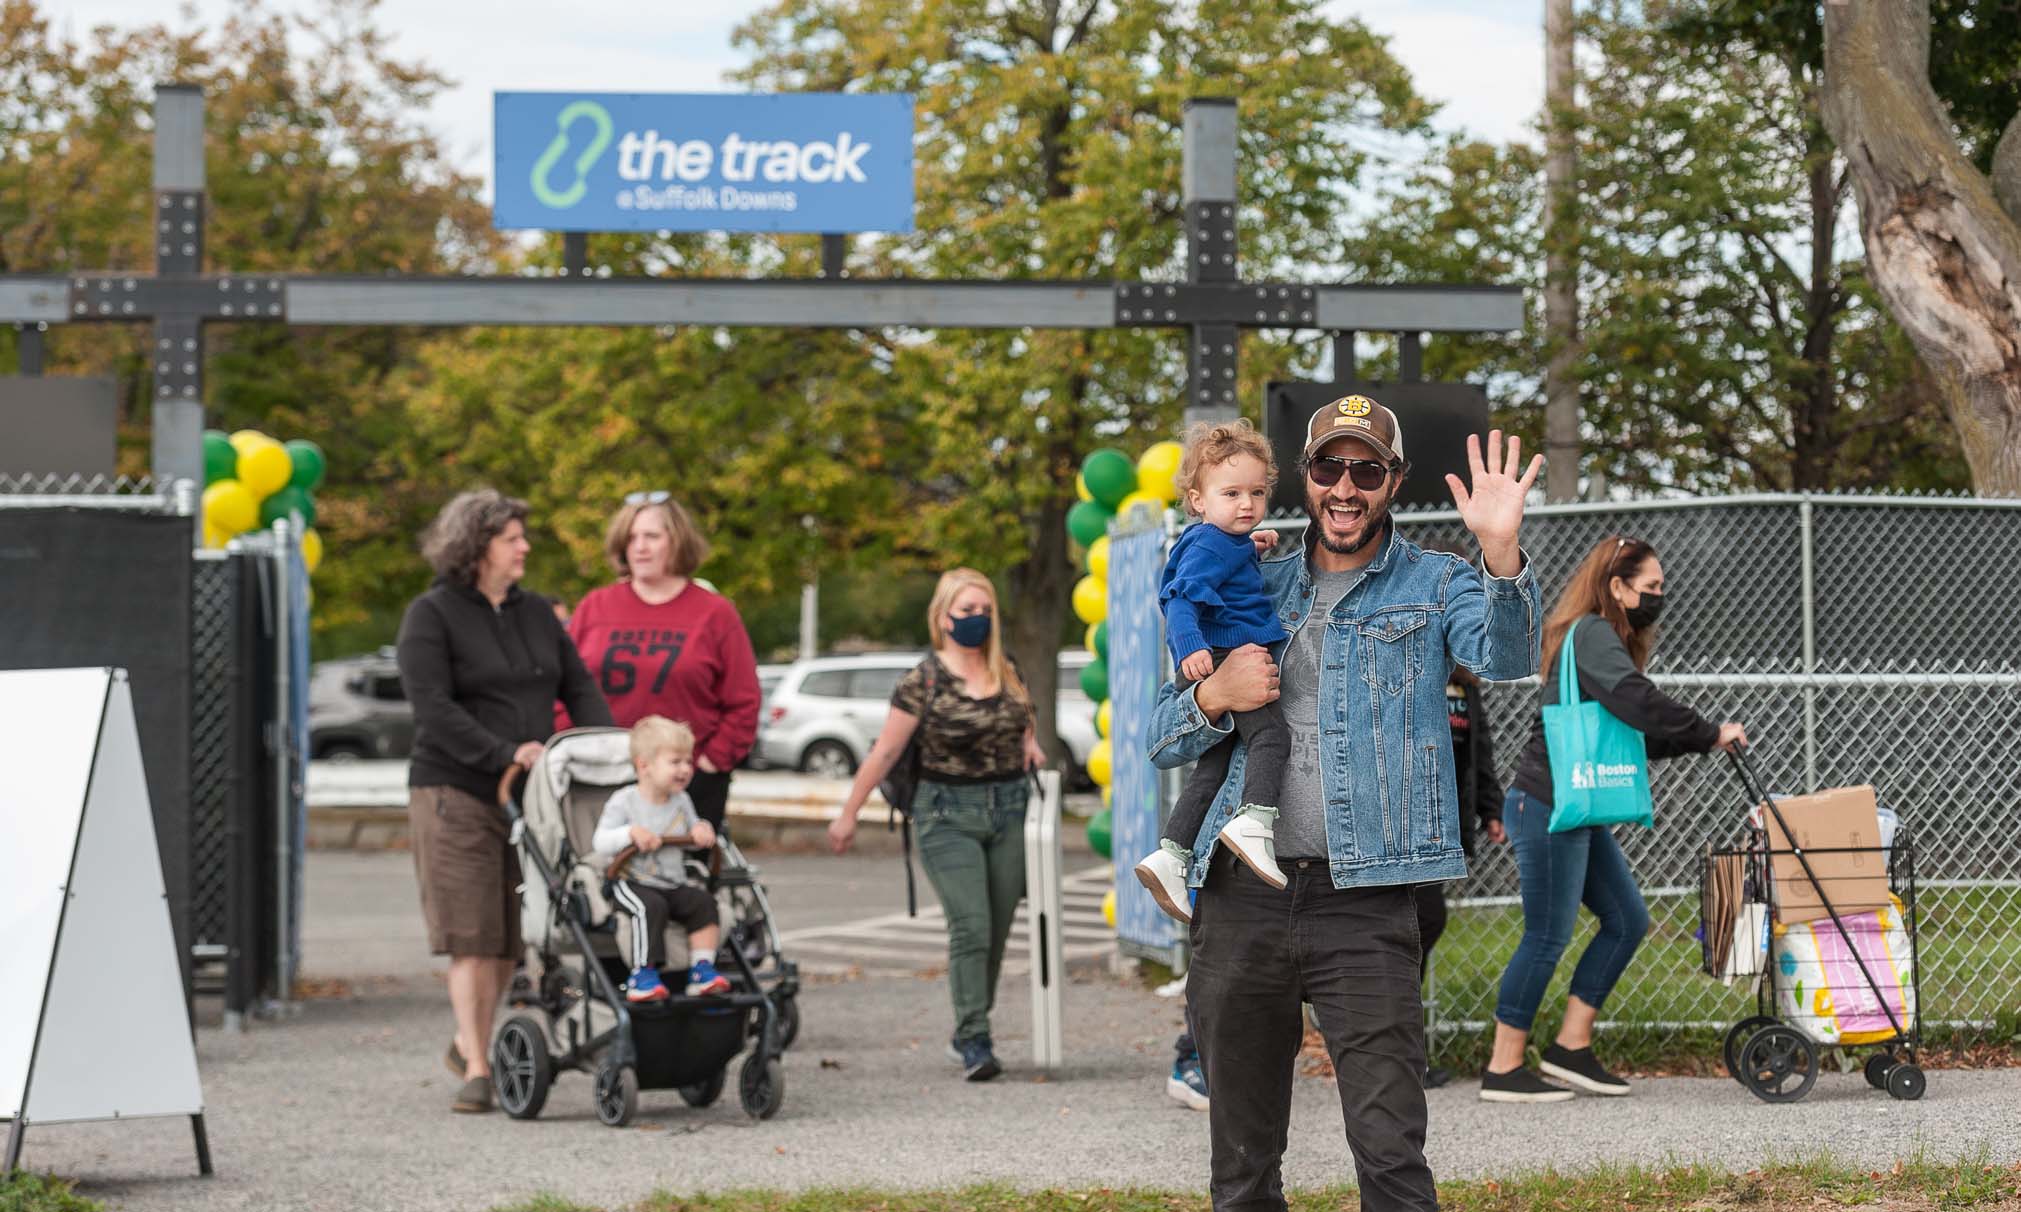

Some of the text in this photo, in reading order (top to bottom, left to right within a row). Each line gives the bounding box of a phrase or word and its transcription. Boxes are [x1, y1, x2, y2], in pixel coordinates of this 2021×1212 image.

[618, 130, 871, 183] the track
[635, 184, 717, 210] Suffolk
[720, 186, 797, 211] Downs
[609, 629, 687, 643] BOSTON
[602, 643, 682, 695] 67
[1597, 763, 1638, 776] Boston
